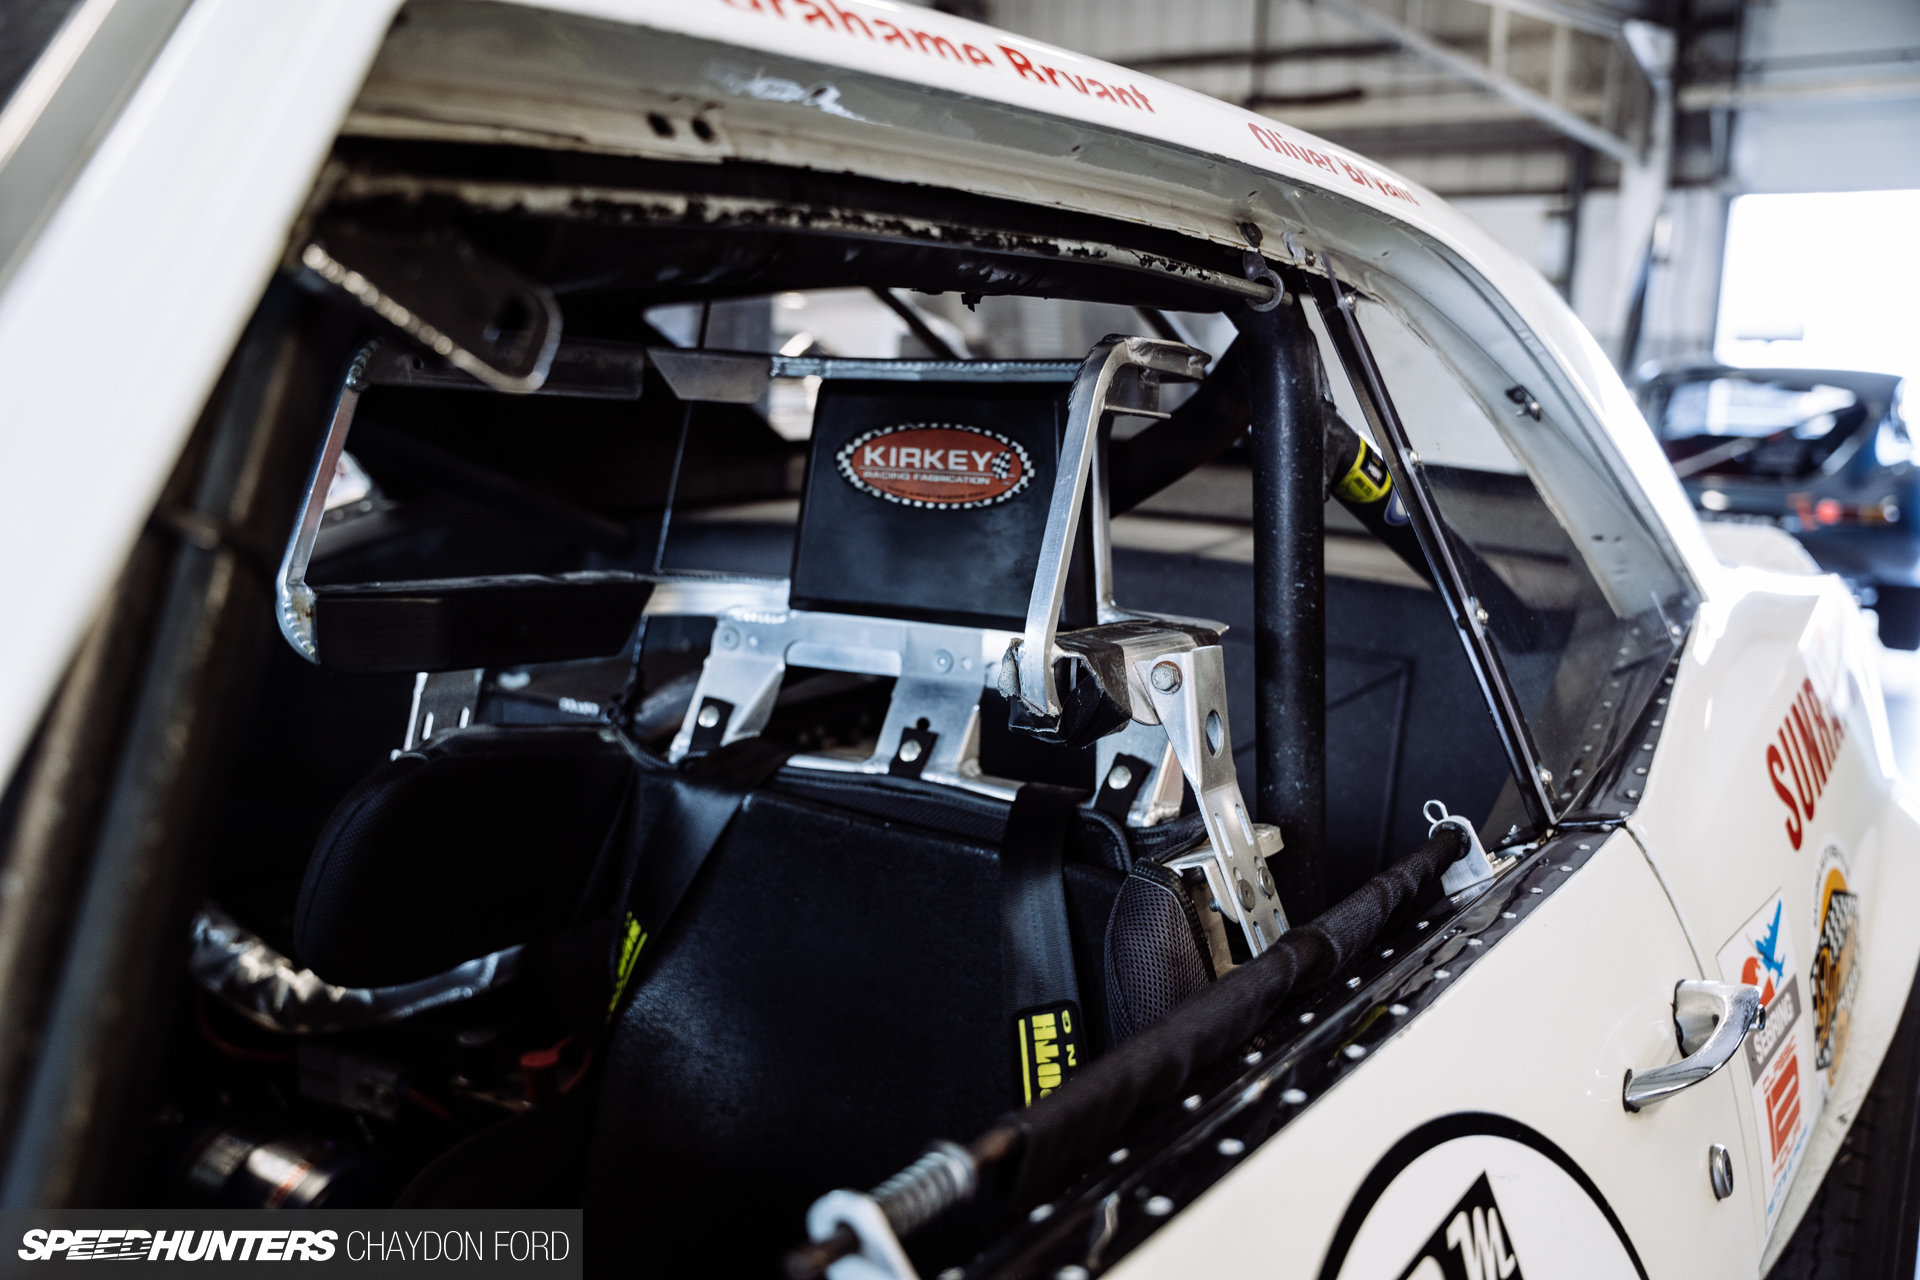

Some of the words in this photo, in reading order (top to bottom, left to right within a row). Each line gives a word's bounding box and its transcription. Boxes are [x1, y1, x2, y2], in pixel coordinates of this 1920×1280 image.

[863, 445, 993, 472] KIRKEY
[862, 470, 910, 481] RACING
[913, 474, 991, 486] FABRICATION
[1753, 991, 1795, 1066] SEBRING
